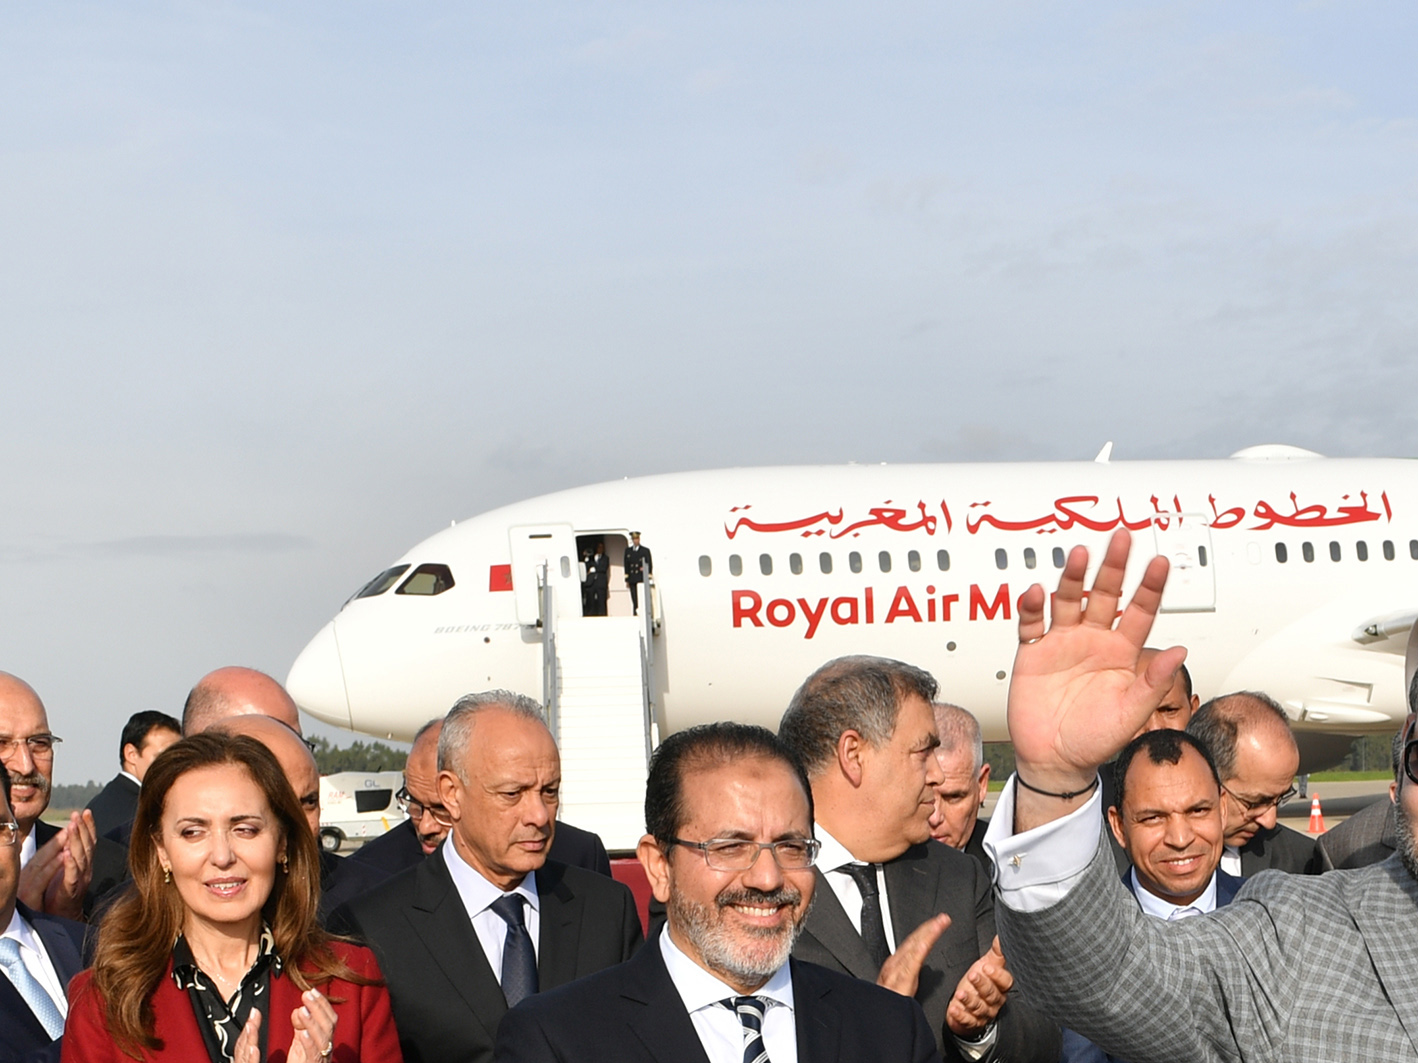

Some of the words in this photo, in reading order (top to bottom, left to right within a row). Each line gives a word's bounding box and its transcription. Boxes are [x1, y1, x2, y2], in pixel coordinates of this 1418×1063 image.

[724, 498, 953, 540] المغربية
[966, 493, 1184, 536] الملكية
[1202, 489, 1393, 531] الخطوط
[434, 624, 491, 634] BOEING
[732, 587, 874, 639] Royal
[886, 585, 959, 623] Air
[364, 779, 380, 788] GL
